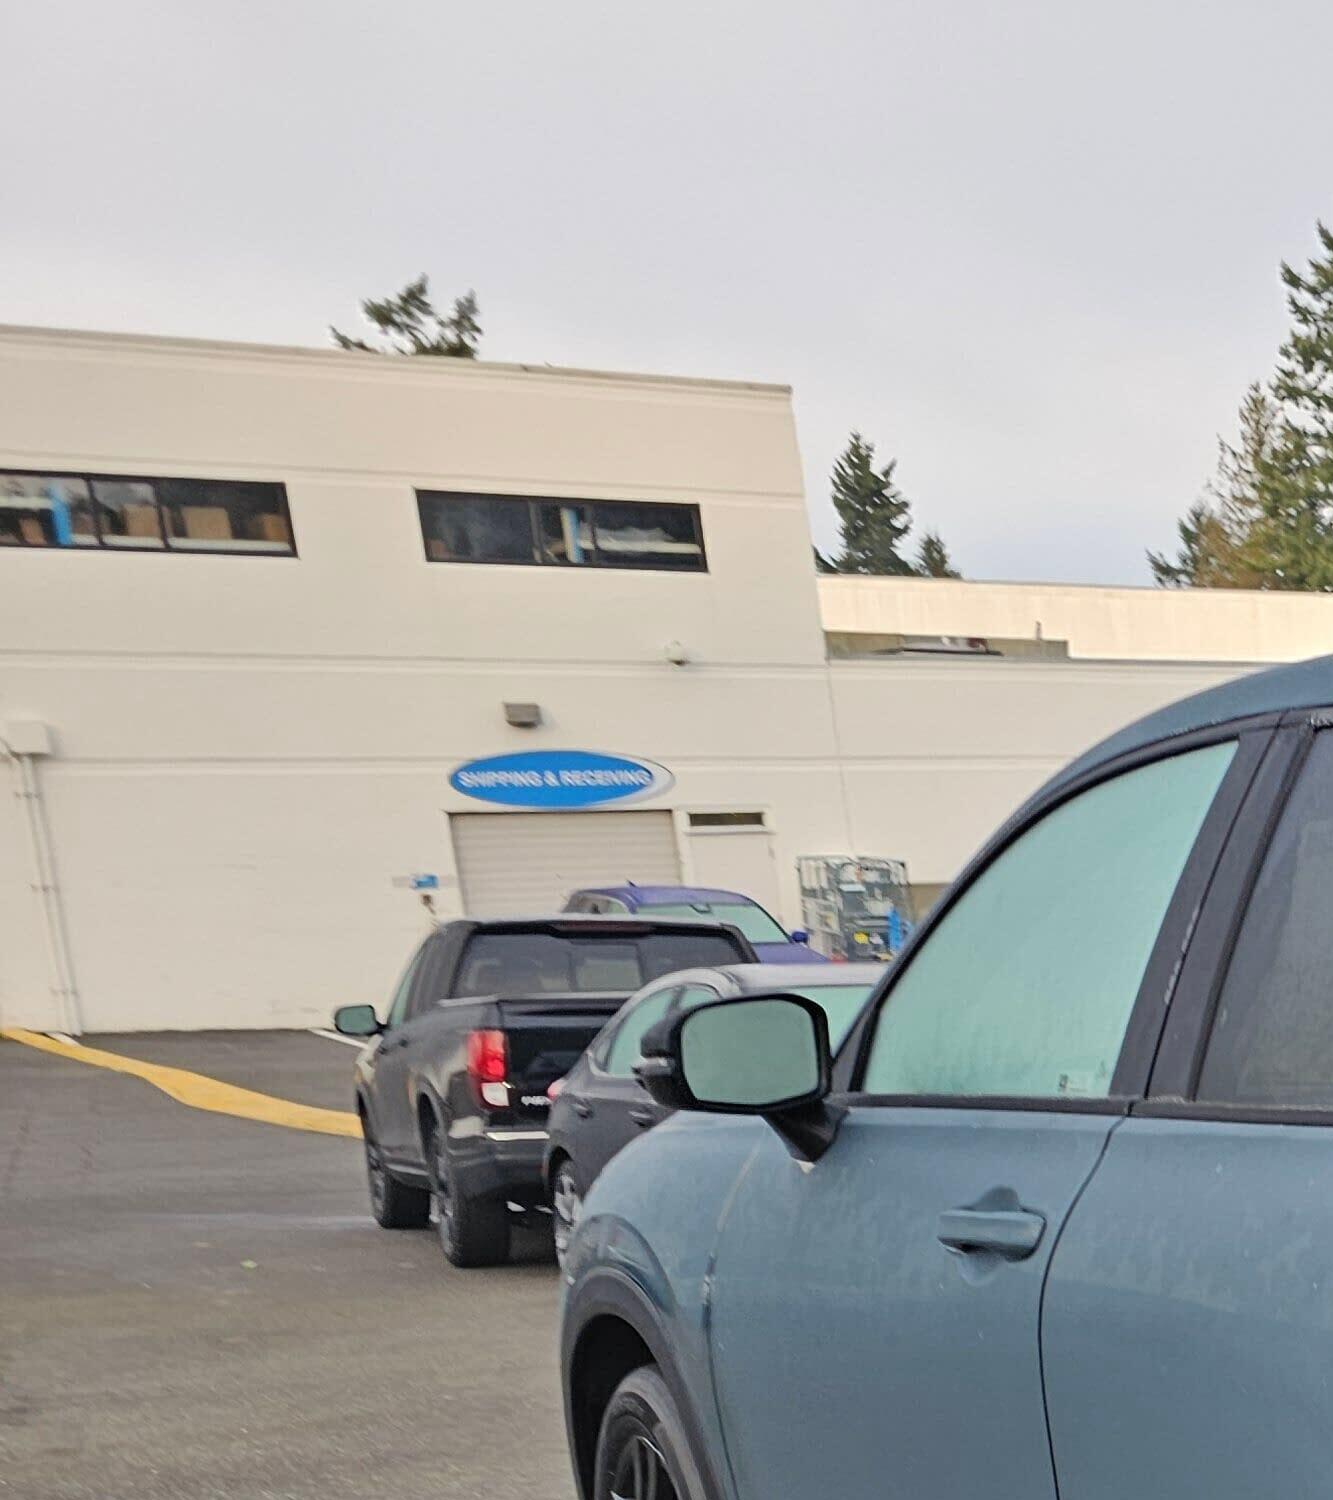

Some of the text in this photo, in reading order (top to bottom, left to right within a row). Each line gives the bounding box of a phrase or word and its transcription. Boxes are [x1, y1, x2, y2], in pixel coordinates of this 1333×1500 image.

[457, 769, 652, 788] SHIPPING & RECEIVING
